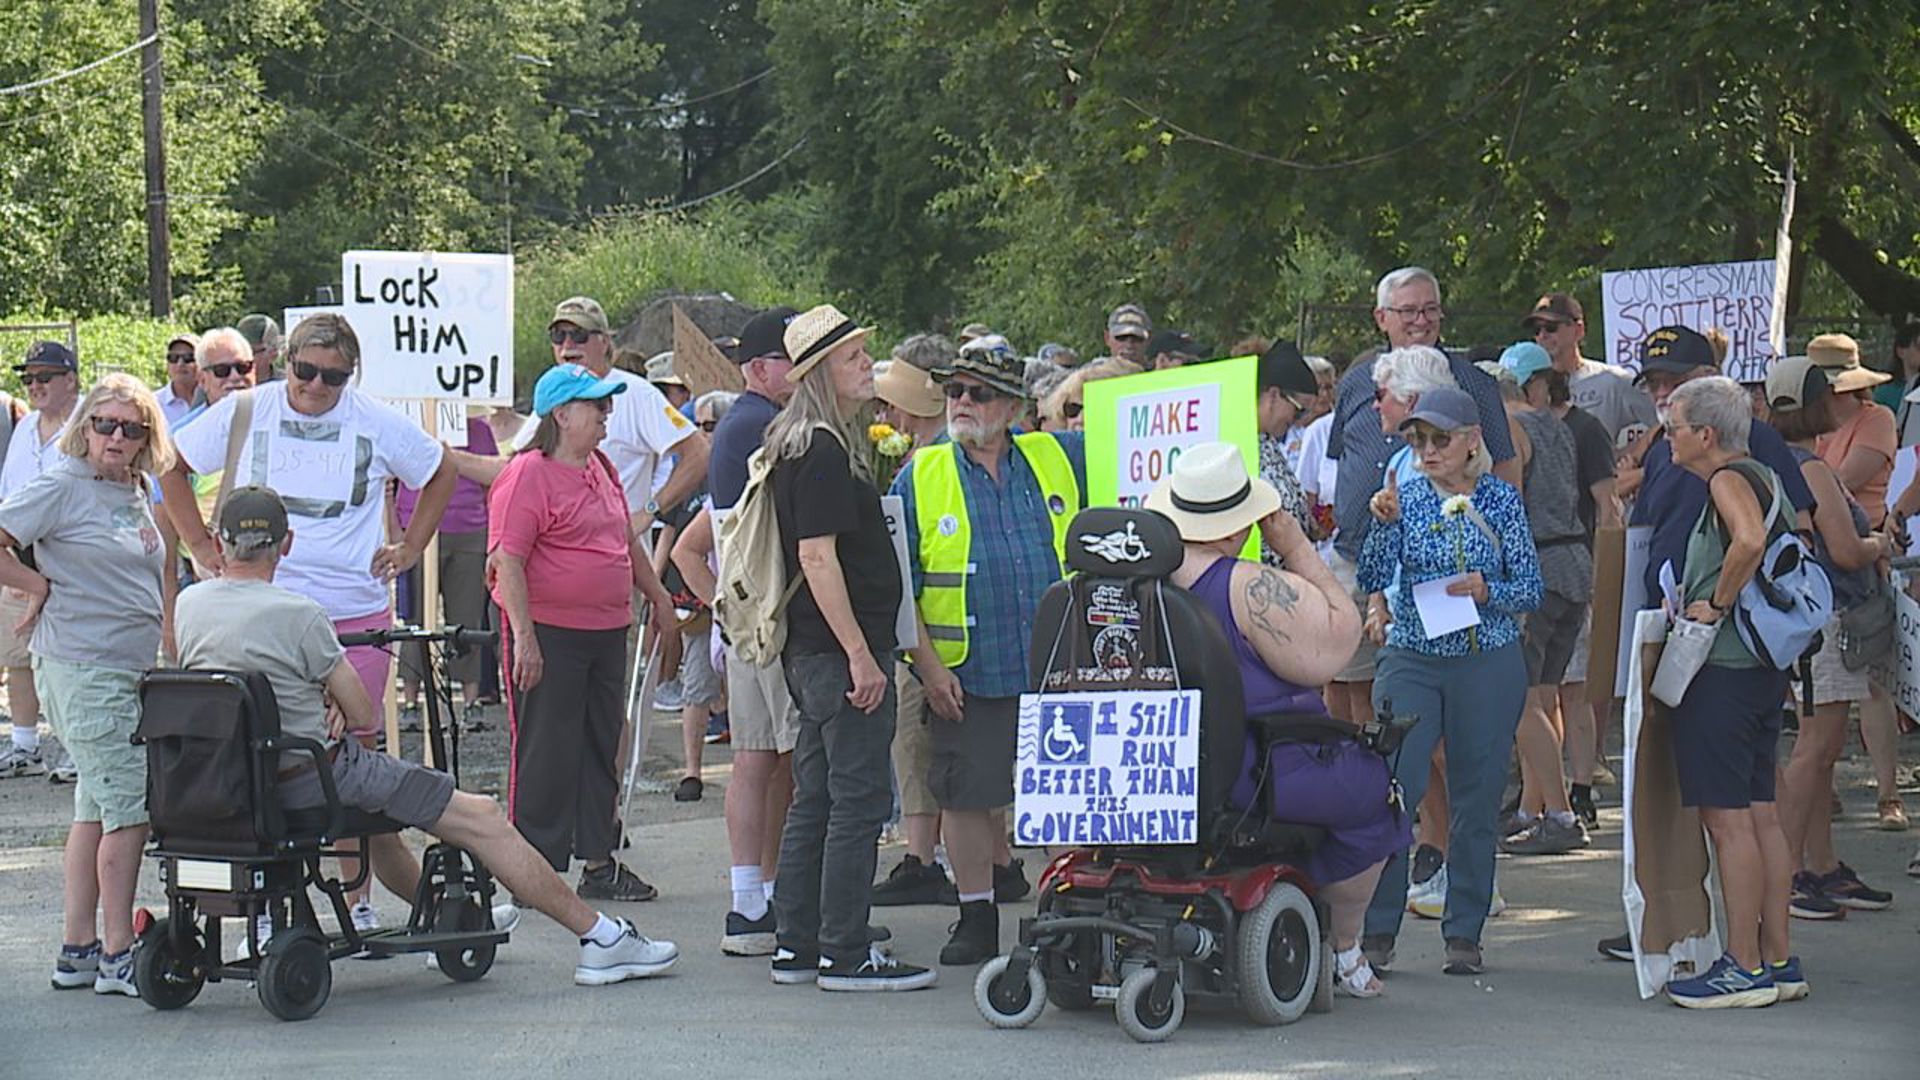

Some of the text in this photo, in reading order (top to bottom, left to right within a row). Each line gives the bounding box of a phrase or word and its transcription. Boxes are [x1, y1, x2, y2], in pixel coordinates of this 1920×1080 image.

[1612, 264, 1774, 304] CONGRESSMAN
[1618, 301, 1709, 341] SCOTT
[436, 355, 499, 397] UP!
[1129, 399, 1200, 438] MAKE
[1096, 701, 1118, 735] I
[1119, 740, 1176, 767] RUN
[1021, 767, 1195, 796] BETTER THAN
[1086, 797, 1128, 811] THIS
[1017, 810, 1195, 843] GOVERNMENT
